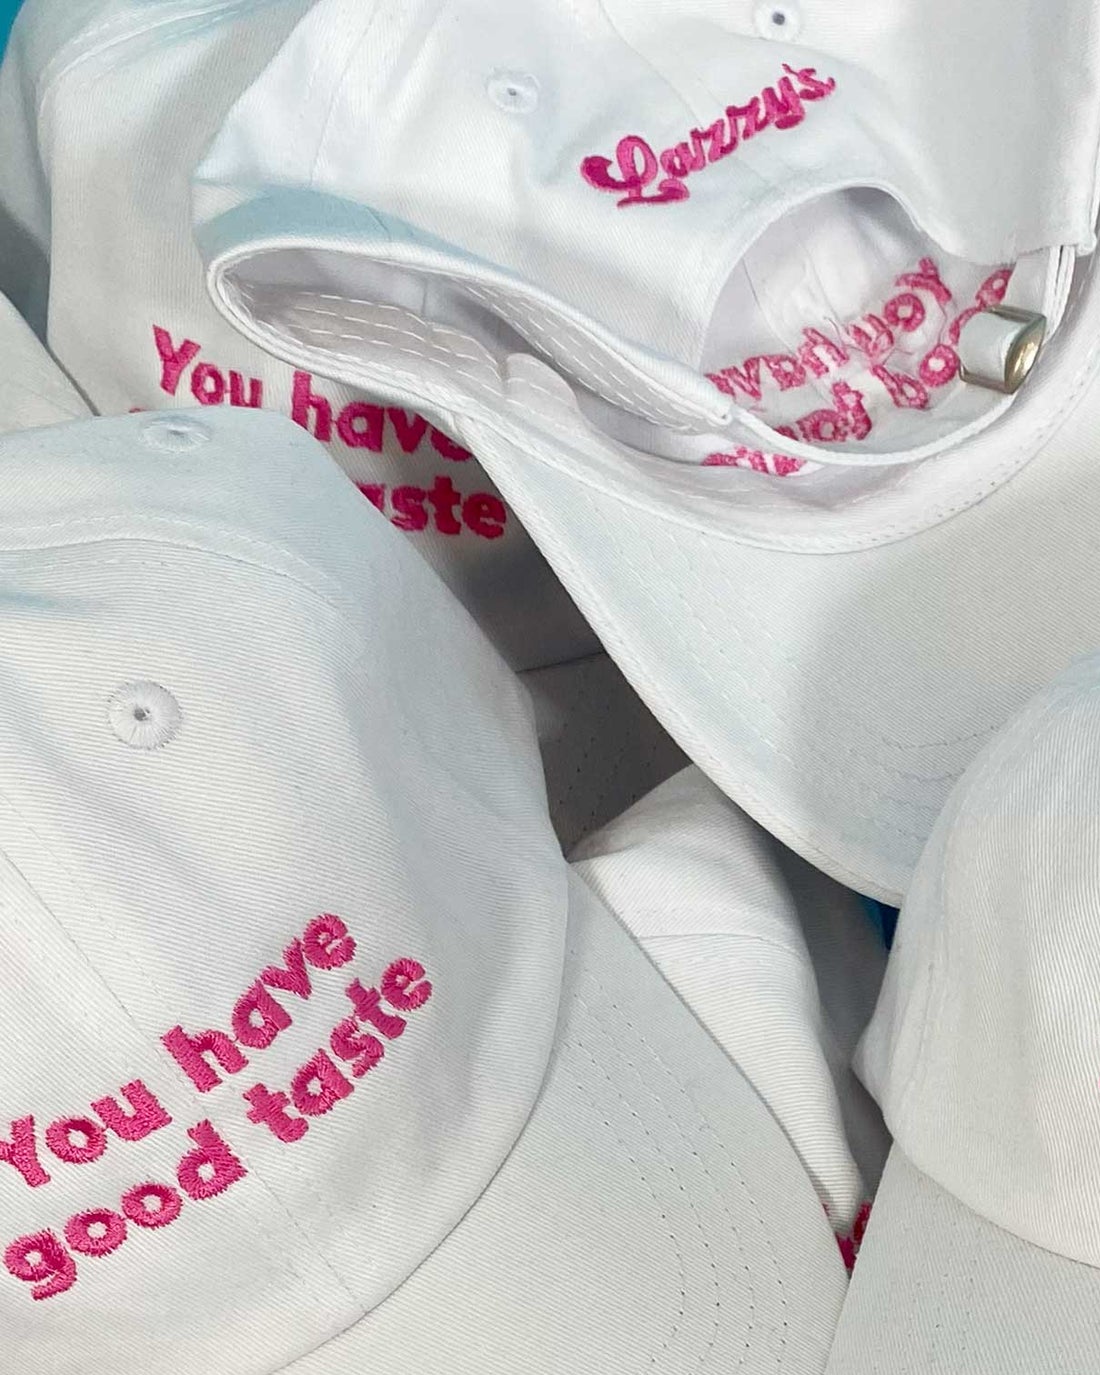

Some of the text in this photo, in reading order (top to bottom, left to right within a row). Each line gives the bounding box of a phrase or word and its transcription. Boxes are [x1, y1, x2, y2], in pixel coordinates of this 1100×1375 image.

[153, 326, 262, 409] You
[0, 914, 357, 1188] You have
[4, 957, 432, 1300] good taste
